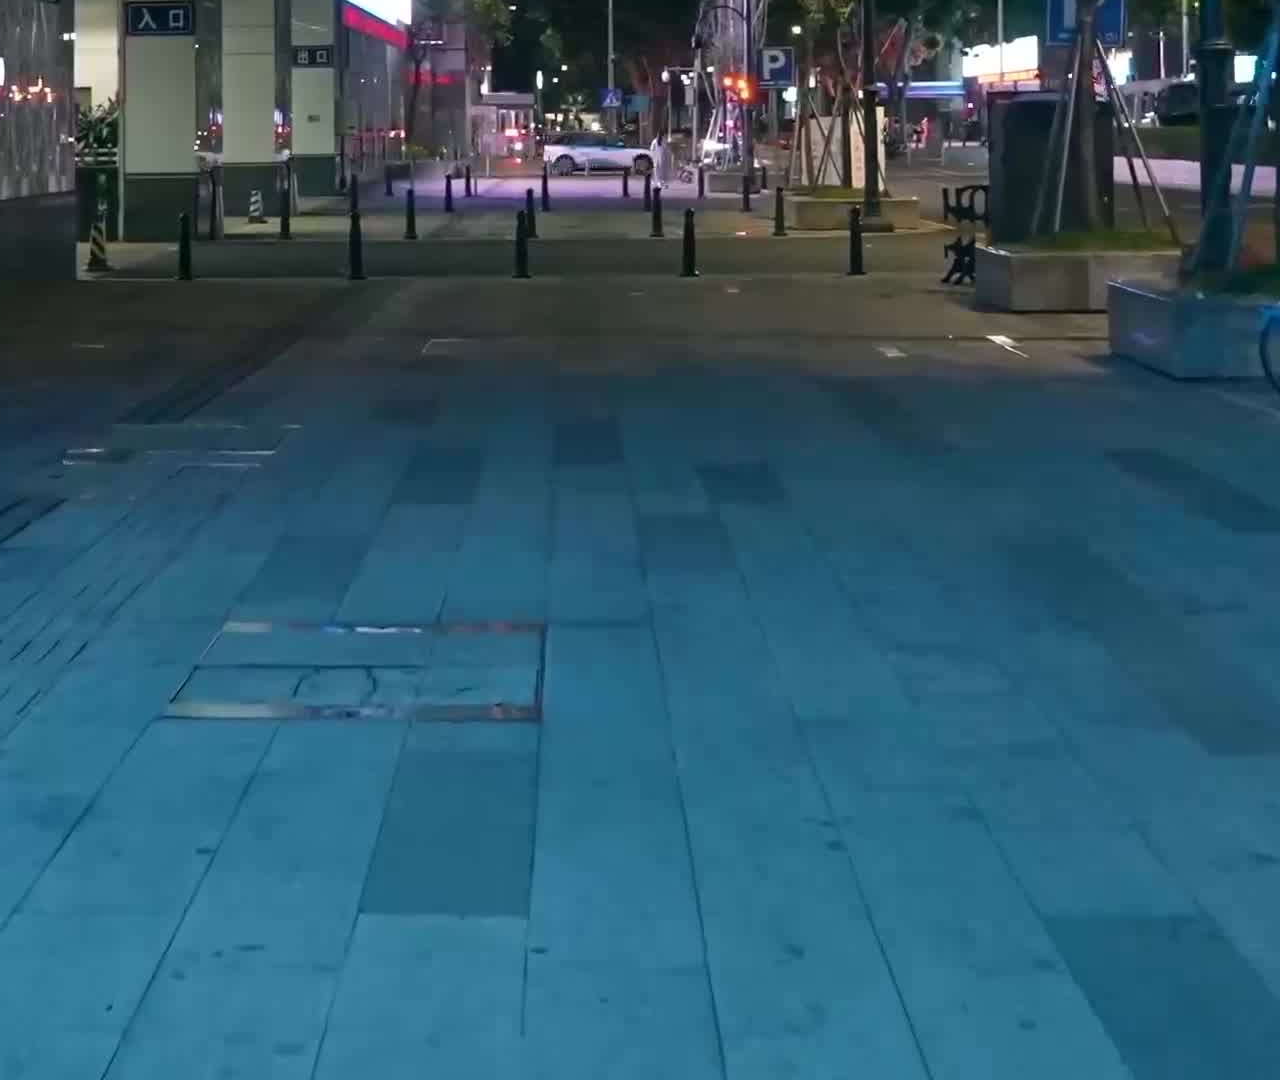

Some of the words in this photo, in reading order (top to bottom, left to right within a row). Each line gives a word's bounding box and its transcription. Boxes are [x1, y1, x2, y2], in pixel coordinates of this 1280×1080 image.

[137, 7, 184, 29] 入口
[297, 49, 328, 64] 出口
[762, 50, 786, 80] P
